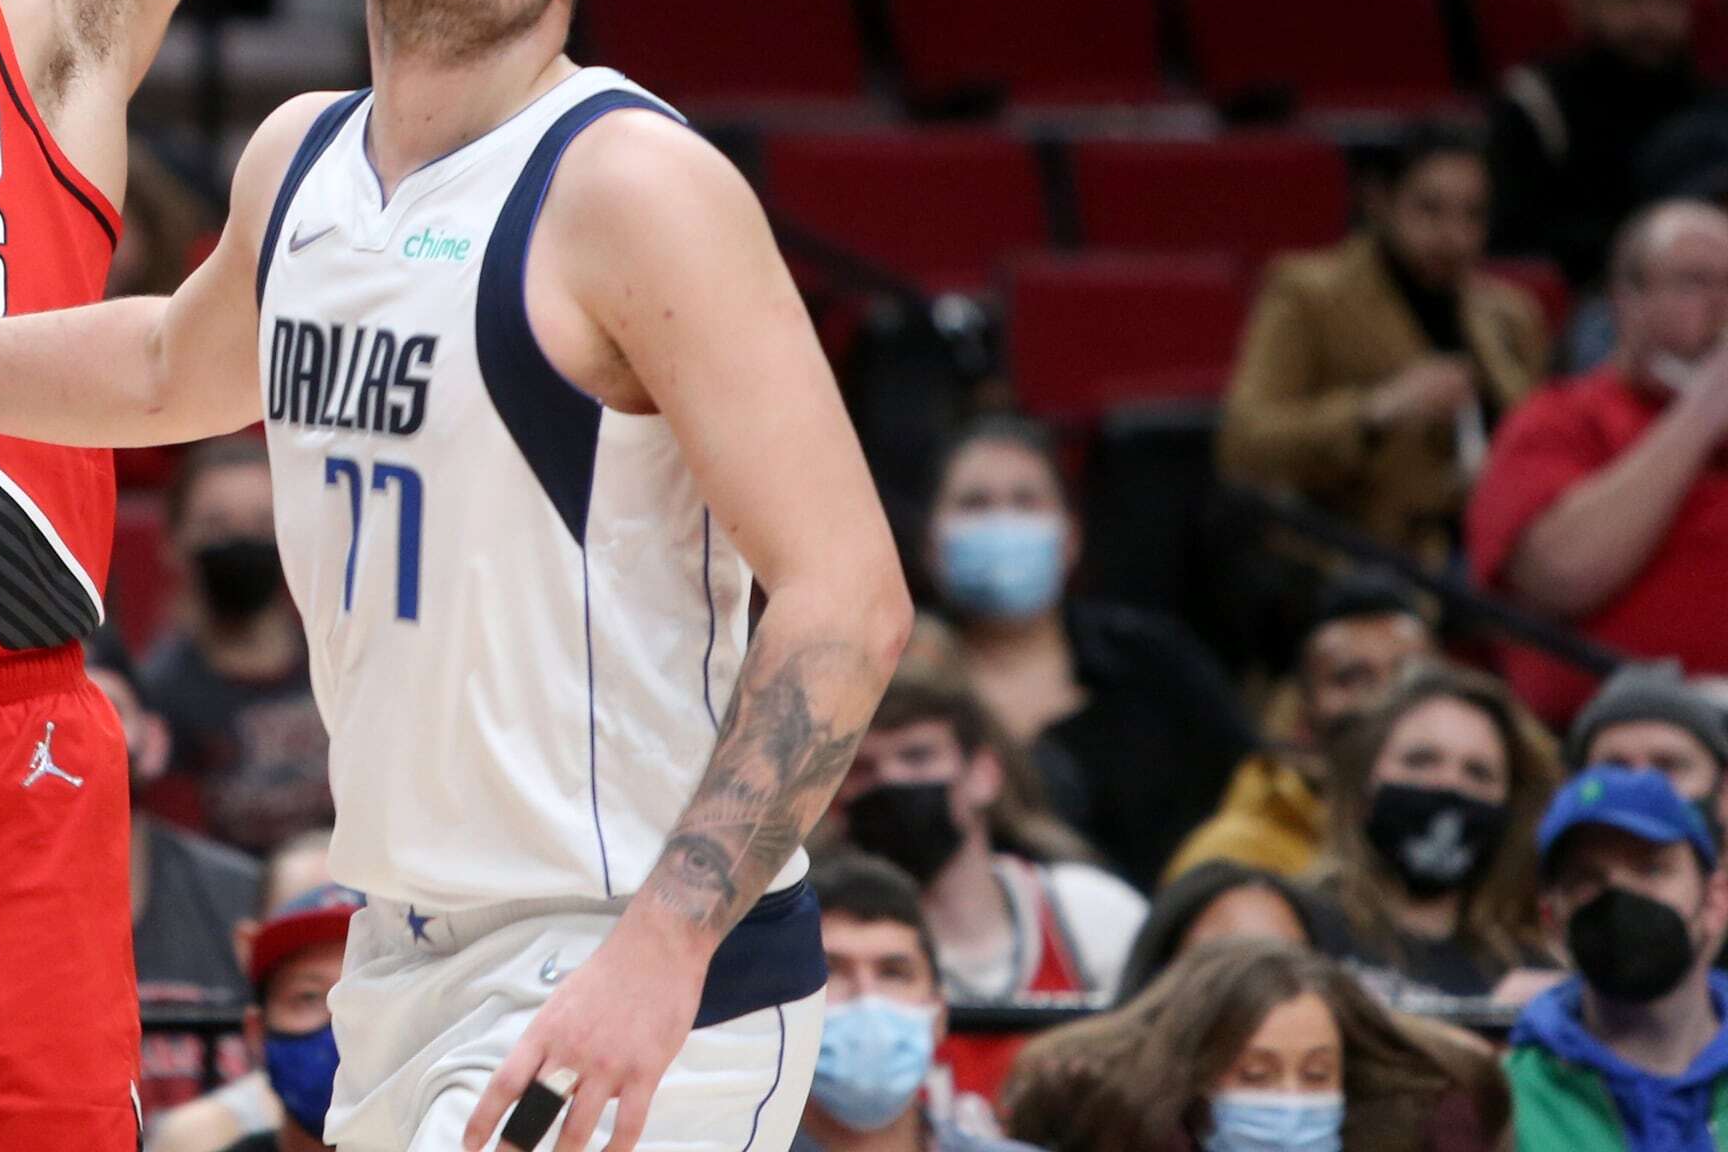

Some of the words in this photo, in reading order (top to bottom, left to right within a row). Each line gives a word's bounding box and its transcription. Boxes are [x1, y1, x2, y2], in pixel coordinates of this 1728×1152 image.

[403, 228, 471, 261] chime
[269, 318, 440, 436] DALLAS
[325, 456, 424, 622] 77
